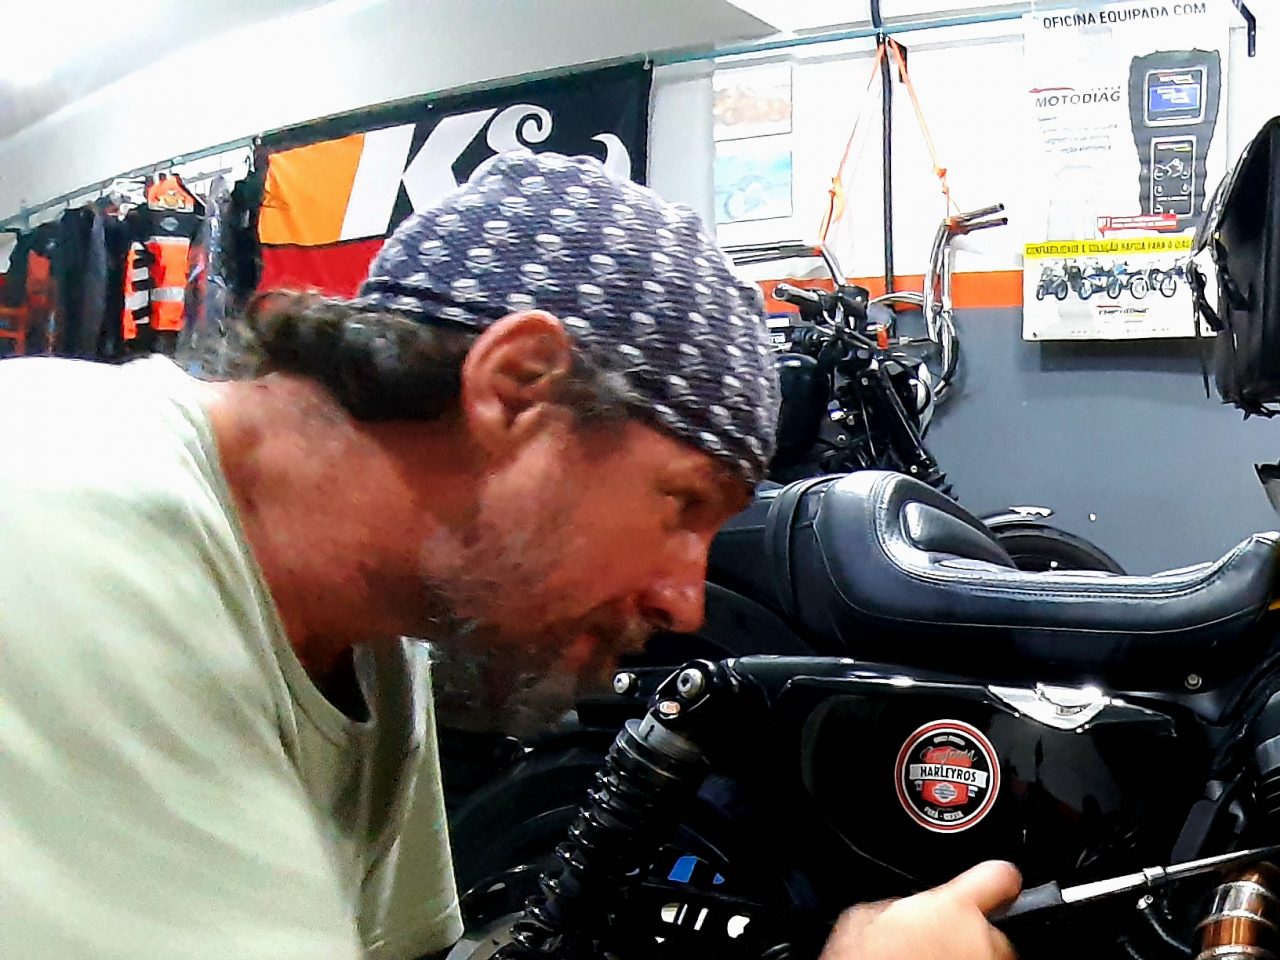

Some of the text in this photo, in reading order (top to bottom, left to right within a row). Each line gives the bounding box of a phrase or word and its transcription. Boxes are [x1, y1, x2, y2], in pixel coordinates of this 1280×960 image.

[1043, 2, 1206, 29] OFICINA EQUIPADA COM
[1035, 91, 1121, 107] MOTODIAG
[920, 765, 977, 783] HARLEYROS
